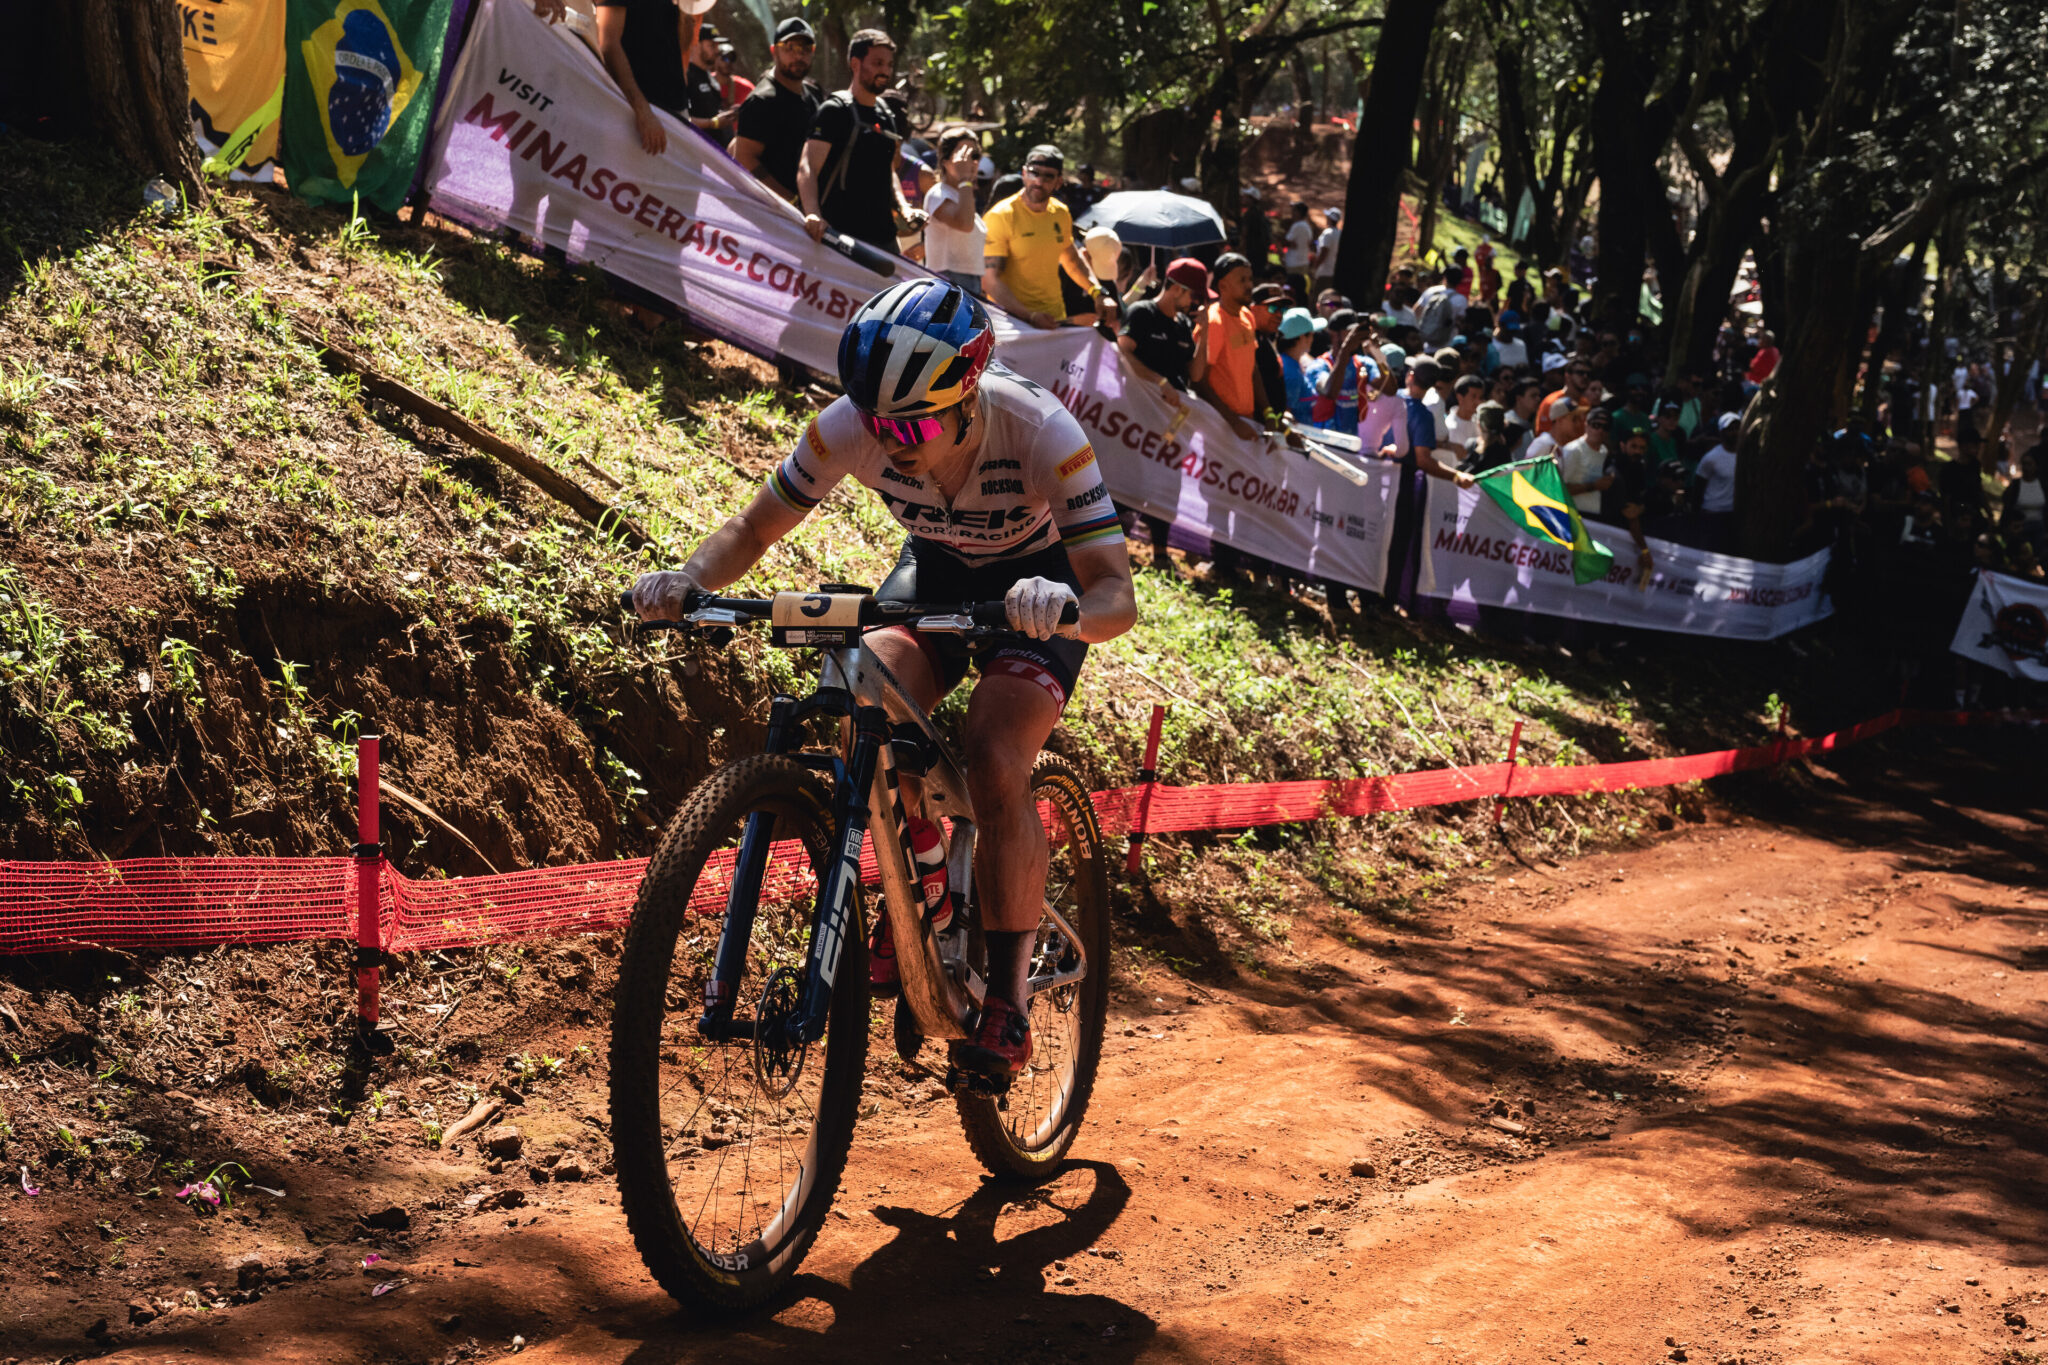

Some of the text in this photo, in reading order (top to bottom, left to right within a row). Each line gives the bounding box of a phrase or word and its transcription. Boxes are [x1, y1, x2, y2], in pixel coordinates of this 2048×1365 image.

[497, 68, 554, 112] VISIT
[1060, 358, 1085, 382] VISIT
[1050, 378, 1300, 518] MINASGERAIS.COM.BR
[870, 487, 1032, 530] TREK
[1443, 511, 1469, 525] VISIT
[960, 516, 1036, 542] RACING
[1434, 527, 1632, 585] MINASGERAIS.BR
[1059, 775, 1089, 812] PIRELLI
[847, 843, 861, 857] SHO
[850, 831, 864, 846] ROC
[816, 926, 827, 955] ULTIMATE
